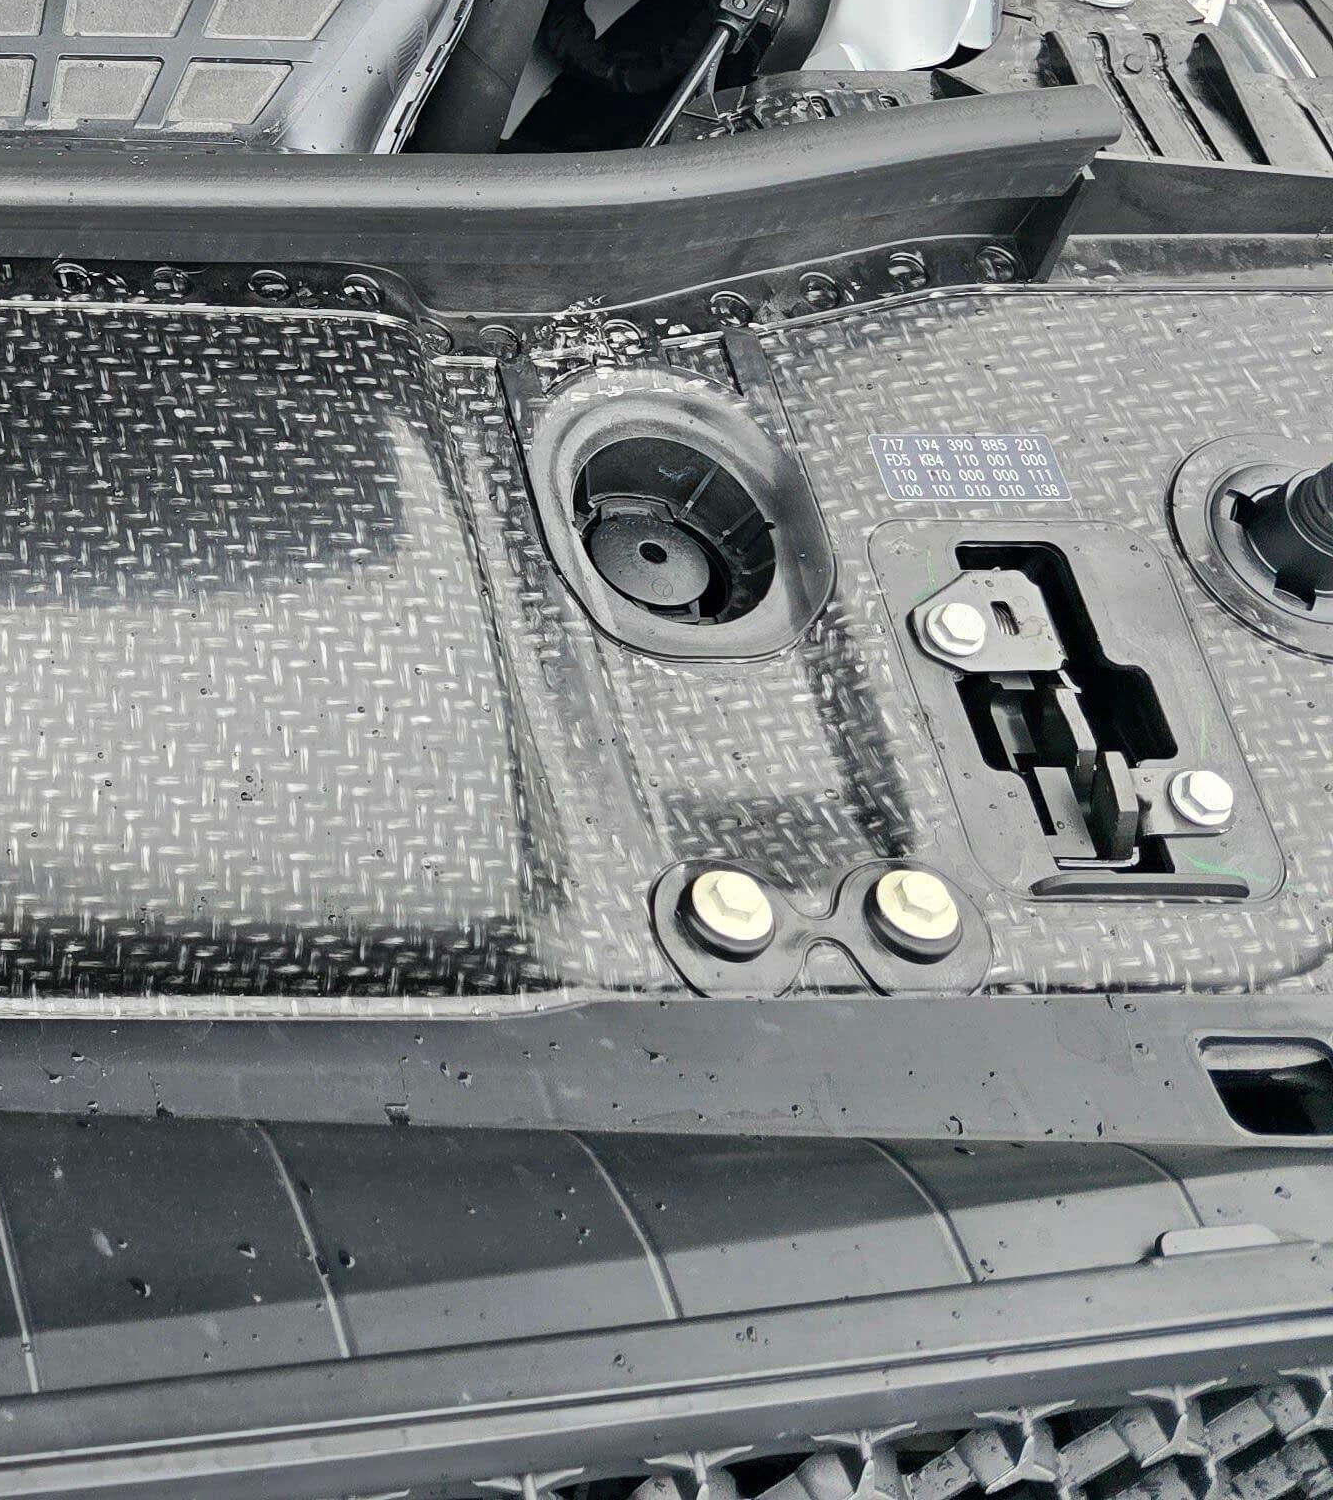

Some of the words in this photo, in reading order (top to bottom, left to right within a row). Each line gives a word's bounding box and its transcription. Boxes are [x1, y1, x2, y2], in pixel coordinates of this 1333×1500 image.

[879, 438, 904, 451] 717
[914, 438, 940, 451] 194
[946, 438, 973, 451] 390
[980, 438, 1007, 451] 885
[1014, 438, 1041, 451] 201
[884, 453, 911, 467] FD5
[918, 453, 944, 467] KB4
[953, 453, 979, 467] 110
[986, 453, 1013, 467] 001
[1020, 453, 1047, 467] 000
[892, 469, 917, 482] 110
[925, 469, 951, 482] 110
[958, 469, 985, 482] 000
[992, 469, 1019, 482] 000
[1027, 469, 1054, 482] 111
[898, 484, 923, 497] 100
[932, 484, 956, 497] 101
[964, 484, 991, 497] 010
[998, 484, 1025, 497] 010
[1033, 484, 1060, 497] 138
